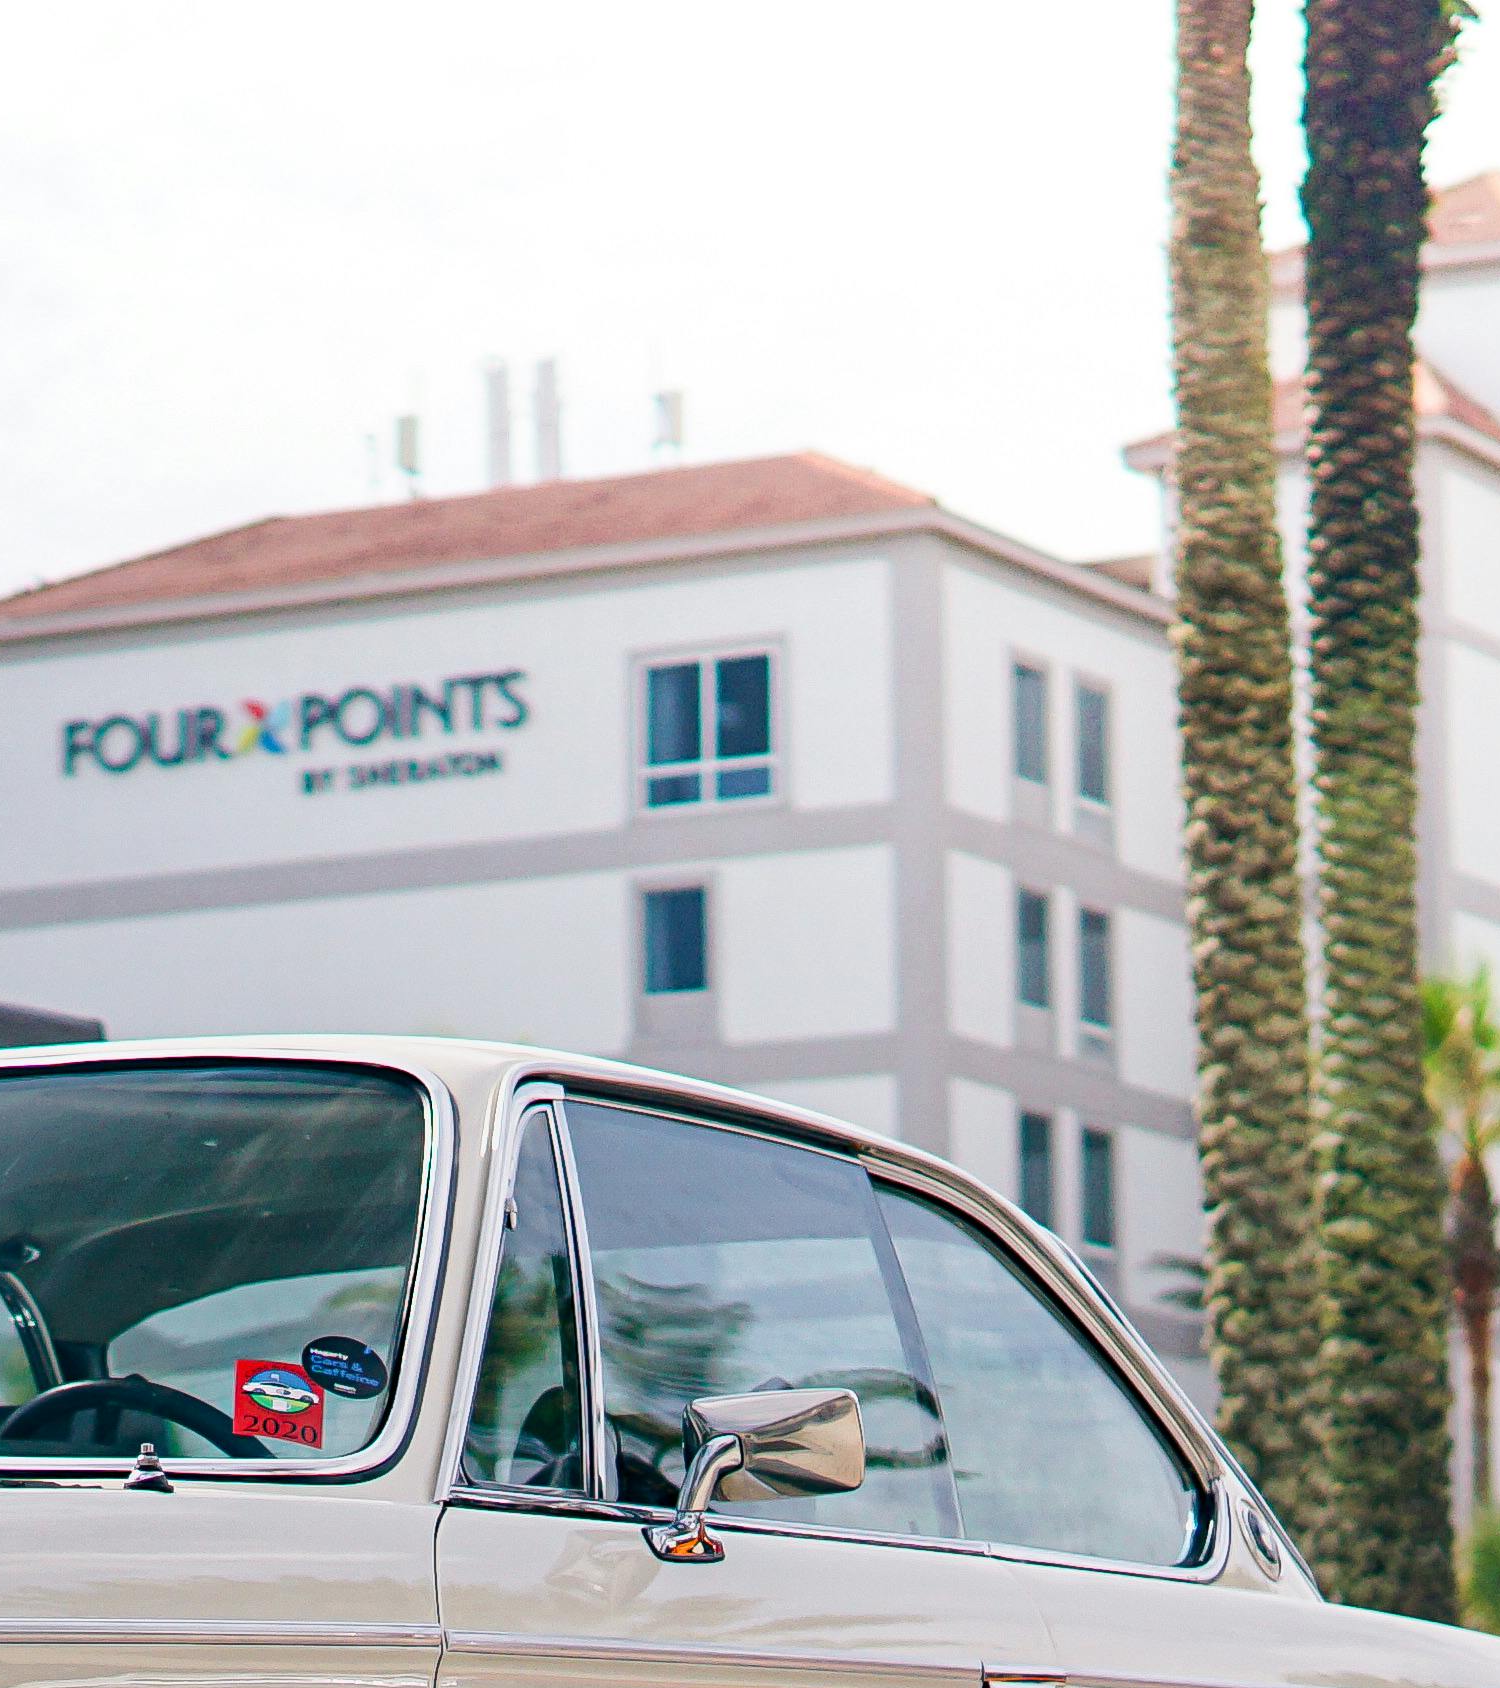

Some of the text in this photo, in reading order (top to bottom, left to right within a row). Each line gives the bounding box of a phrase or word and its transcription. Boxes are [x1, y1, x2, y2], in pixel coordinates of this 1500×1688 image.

[62, 669, 529, 778] FOUR POINTS
[311, 1354, 364, 1374] Cars &
[311, 1364, 381, 1387] Caffeine
[243, 1414, 318, 1444] 2020
